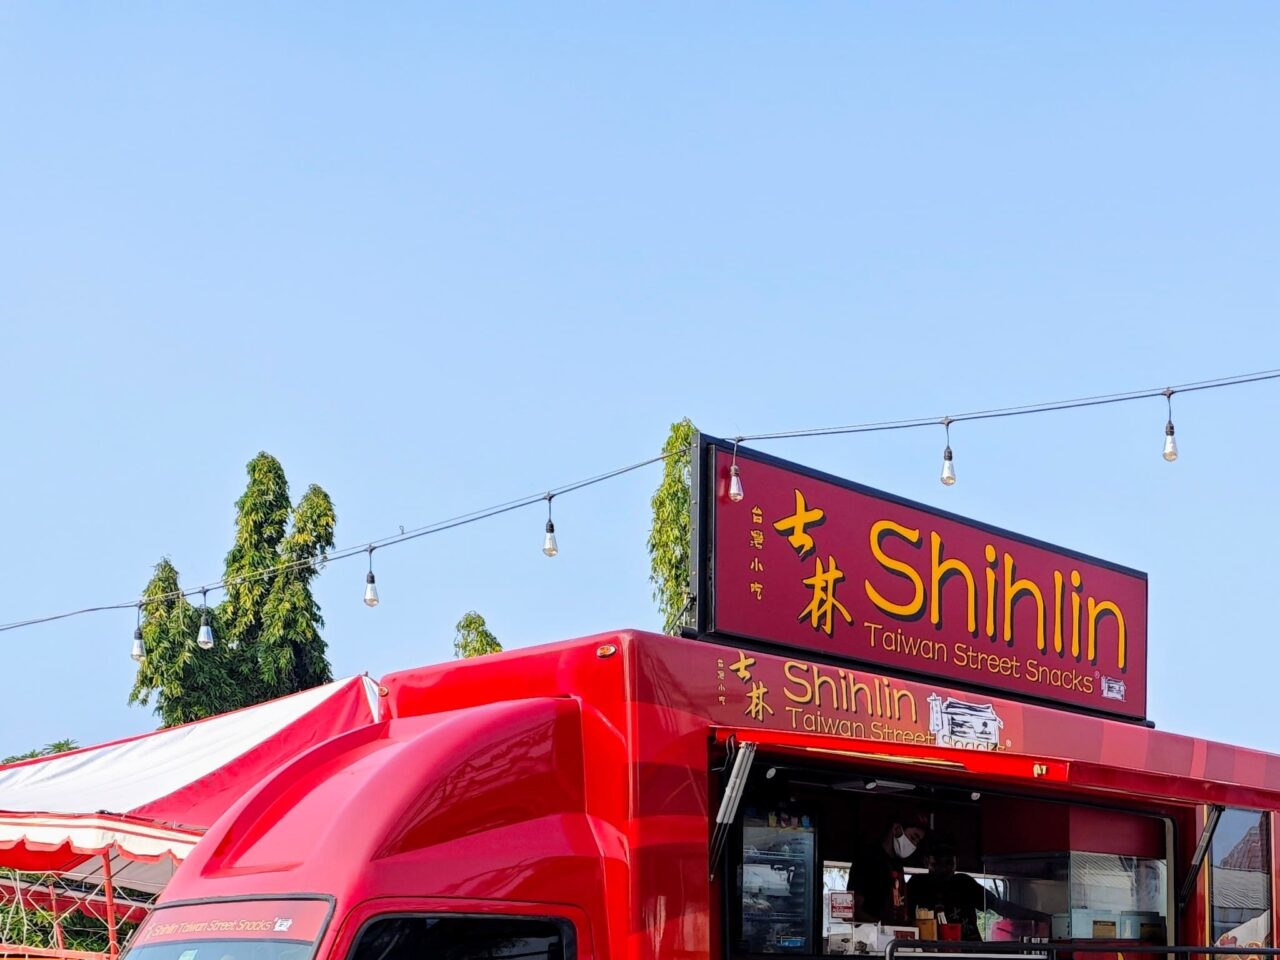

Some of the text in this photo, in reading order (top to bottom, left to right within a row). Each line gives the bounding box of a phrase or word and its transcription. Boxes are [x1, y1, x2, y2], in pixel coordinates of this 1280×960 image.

[773, 488, 853, 635] 士林
[864, 518, 1126, 669] Shihlin
[728, 650, 775, 722] 士林
[783, 661, 917, 723] Shihlin
[864, 620, 1094, 694] Taiwan Street Snacks
[785, 706, 864, 738] Taiwan
[870, 722, 934, 745] Street
